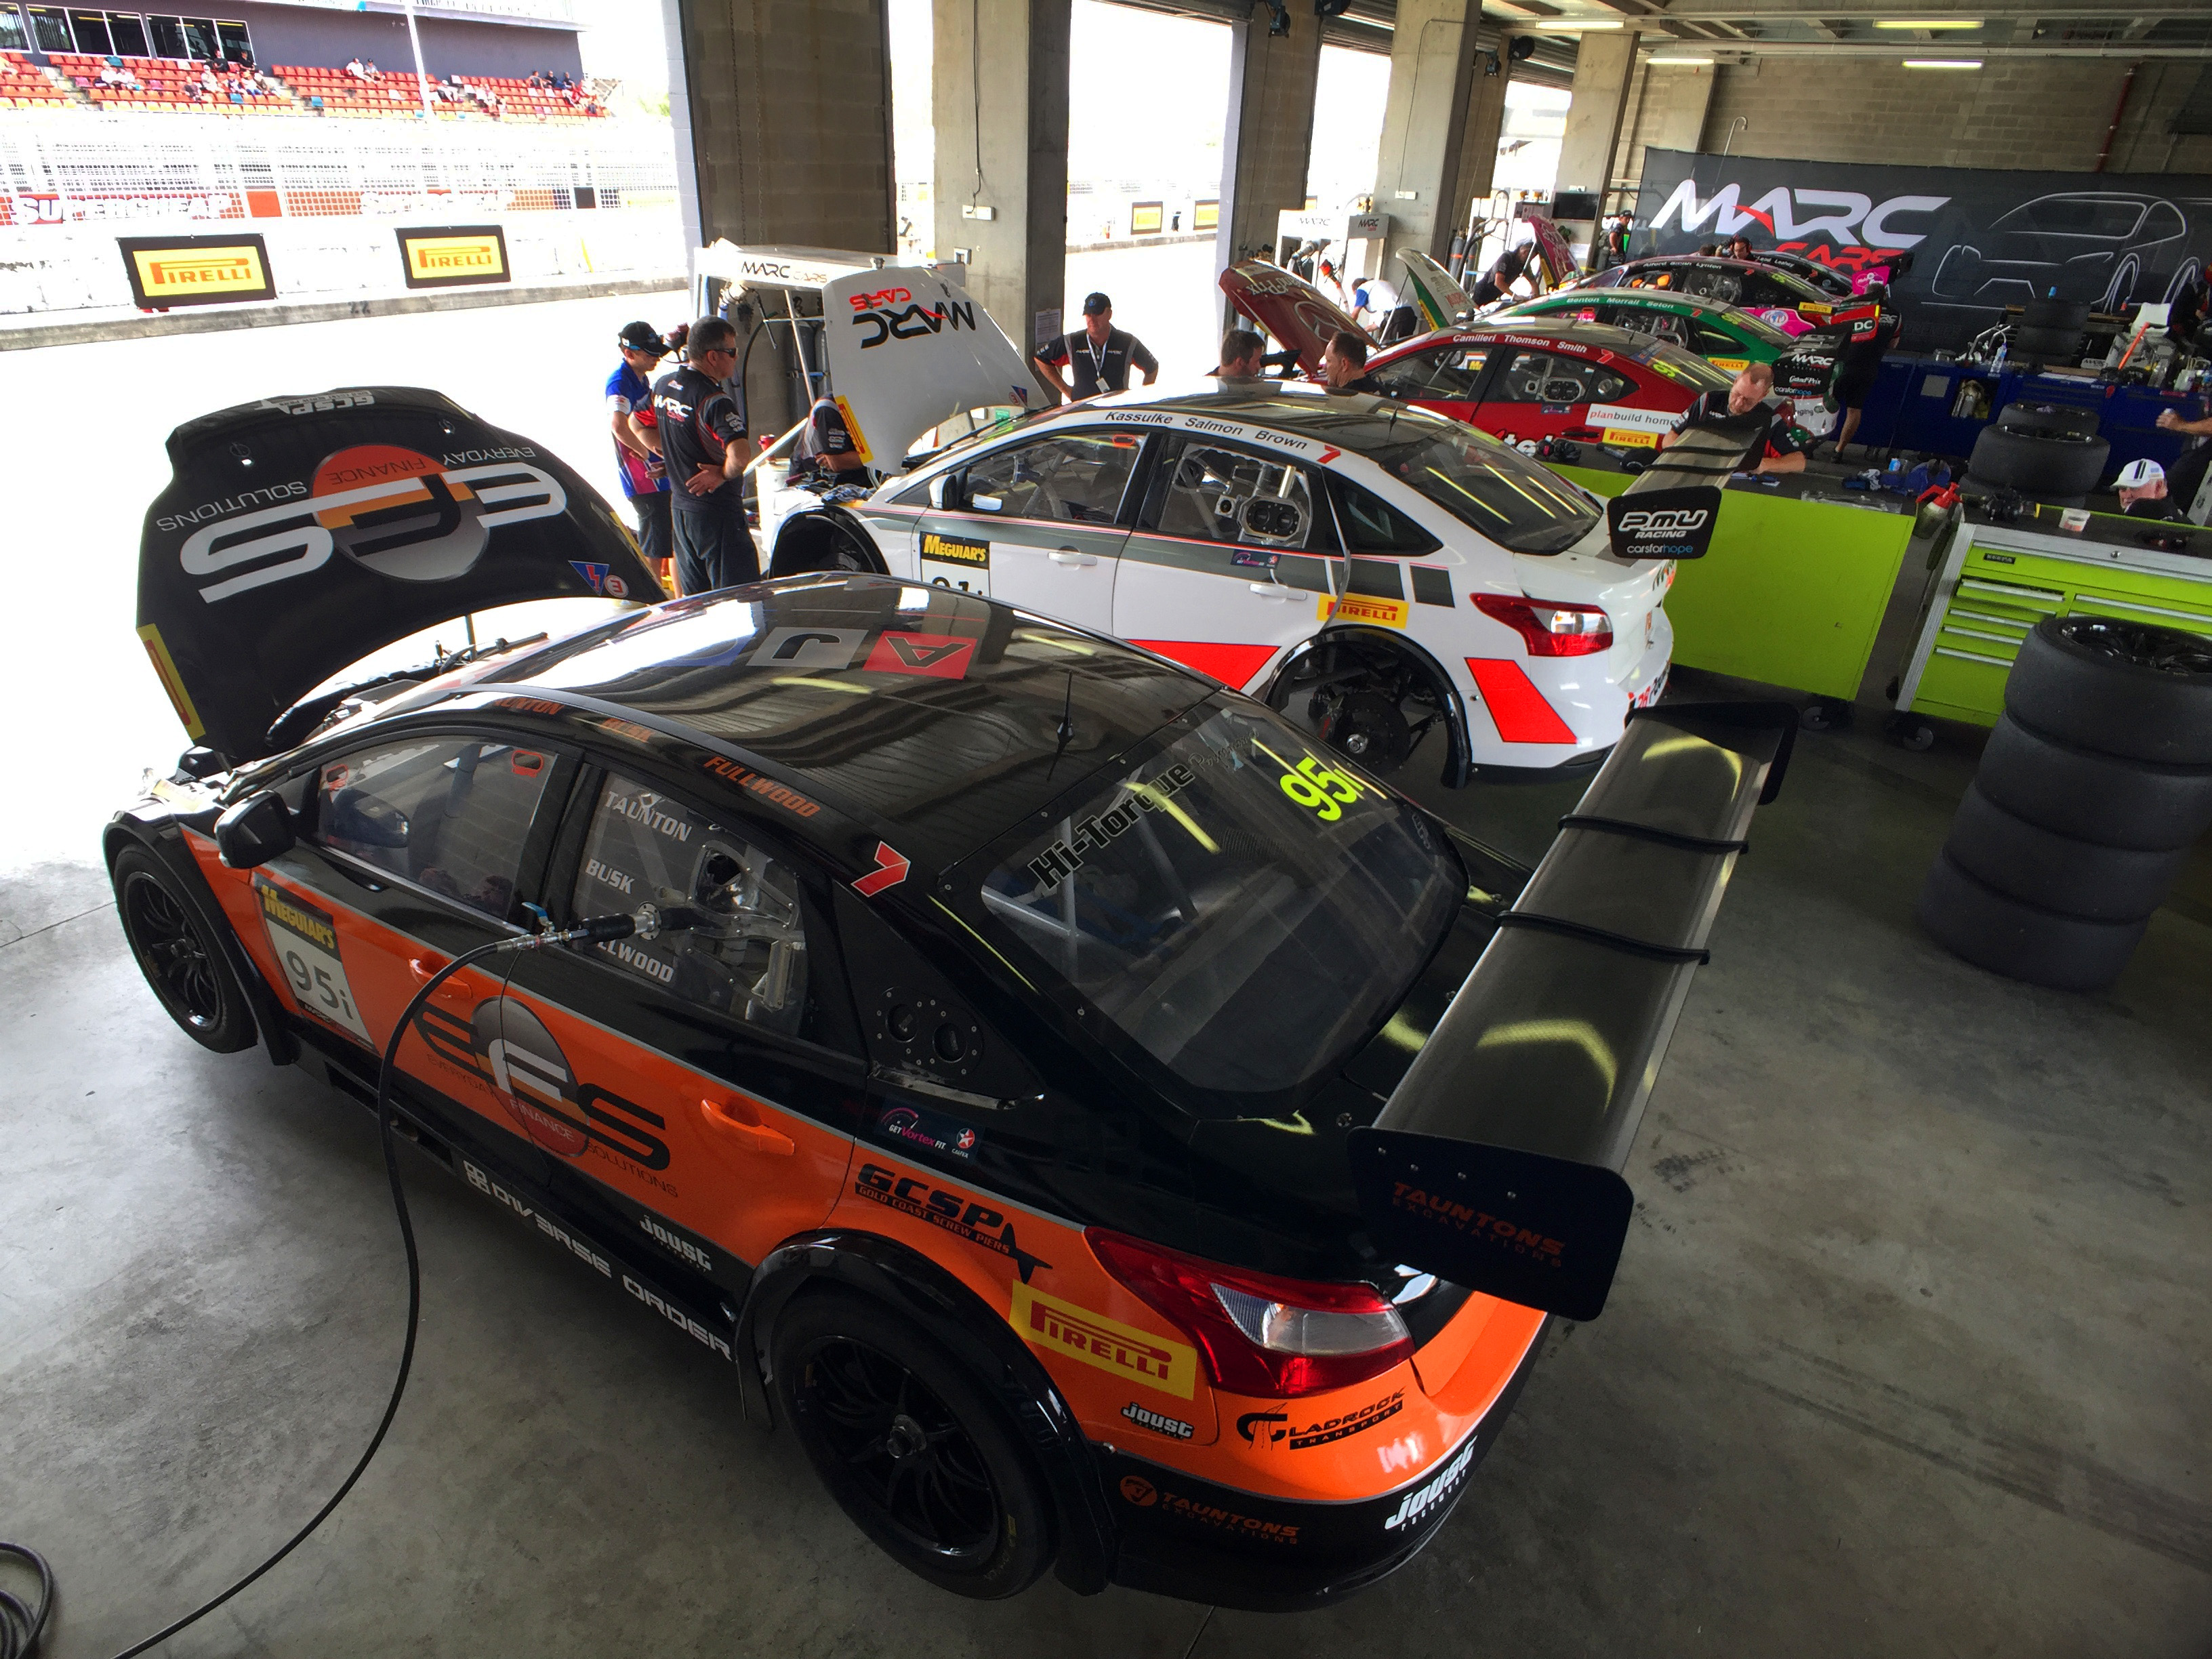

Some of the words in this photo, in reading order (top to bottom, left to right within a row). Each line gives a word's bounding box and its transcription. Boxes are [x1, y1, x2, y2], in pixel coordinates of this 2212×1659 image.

[1358, 218, 1379, 228] MARC
[1649, 179, 1952, 246] MARC
[150, 258, 251, 284] PIRELLI
[418, 247, 492, 268] PIRELLI
[741, 260, 791, 279] MARC
[793, 270, 827, 283] CARS
[849, 287, 912, 311] CARS
[1646, 300, 1675, 309] Seton
[853, 301, 977, 349] MARC
[1854, 320, 1873, 331] DC
[1452, 334, 1497, 343] Camilleri
[1504, 335, 1550, 347] Thomson
[1557, 341, 1588, 354] Smith
[1711, 360, 1744, 369] PIRELLI
[1791, 354, 1835, 366] MARC
[1589, 409, 1642, 423] planbuild
[1105, 410, 1173, 426] Kassulke
[1185, 417, 1244, 436] Salmon
[1254, 429, 1309, 450] Brown
[1610, 431, 1651, 445] PIRELLI
[442, 447, 536, 466] EVERYDAY
[331, 458, 427, 485] FINANCE
[156, 481, 308, 533] SOLUTIONS
[1635, 530, 1687, 540] RACING
[1626, 544, 1694, 556] carsforhope
[1326, 599, 1398, 622] PIRELLI
[703, 756, 821, 818] FULLWOOD
[606, 791, 693, 842] TAUNTON
[1027, 760, 1195, 891] Hi-Torque
[585, 858, 635, 895] BUSK
[286, 950, 354, 1020] 95i
[509, 1099, 575, 1143] FINANCE
[888, 1124, 902, 1134] GET
[901, 1126, 937, 1147] Vortex
[951, 1148, 969, 1159] CALTEX
[588, 1143, 678, 1198] SOLUTIONS
[857, 1163, 1004, 1229] GCSP
[859, 1186, 888, 1204] GOLD
[891, 1198, 928, 1219] COAST
[933, 1214, 972, 1237] SCREW
[976, 1231, 1010, 1254] PIERS
[1394, 1182, 1565, 1256] TAUNTONS
[622, 1275, 733, 1362] ORDER
[1030, 1300, 1172, 1380] PIRELLI
[1296, 1404, 1401, 1446] TRANSPORT
[1163, 1492, 1301, 1537] TAUNTONS
